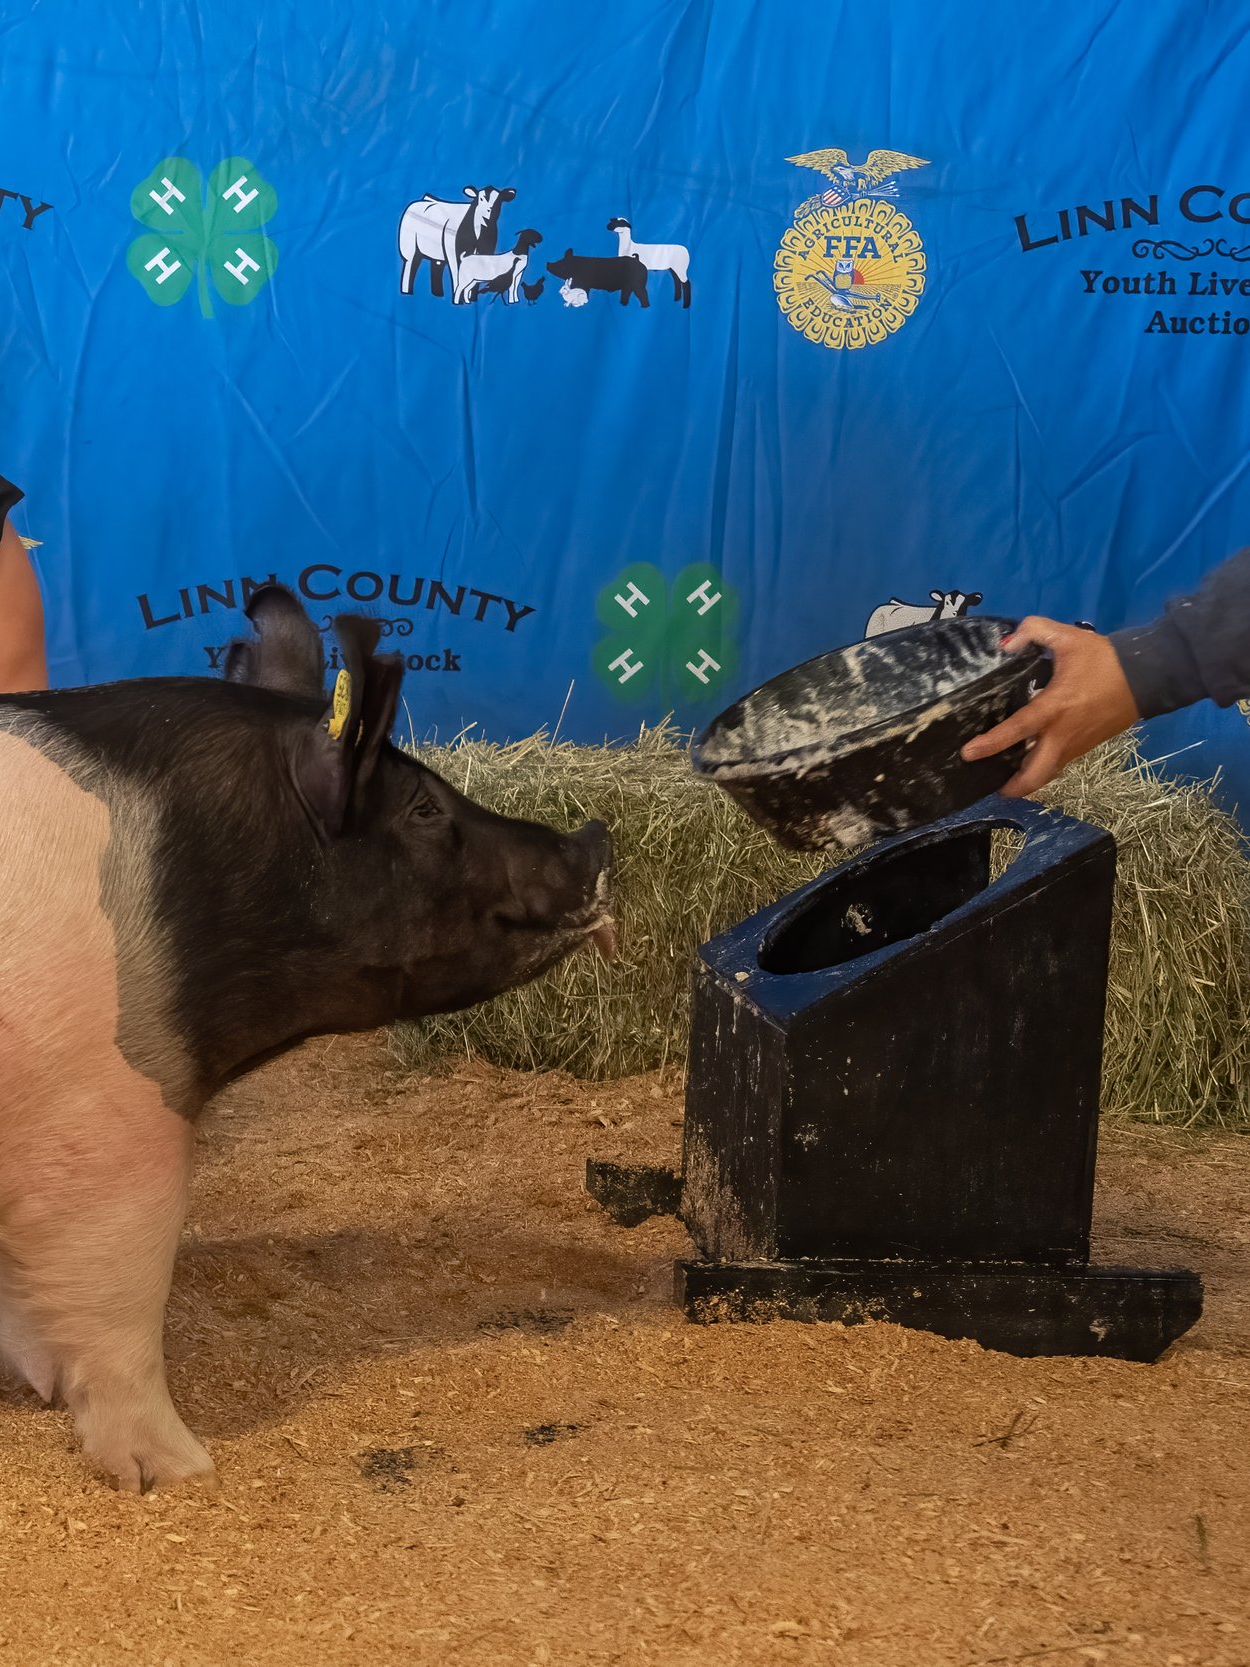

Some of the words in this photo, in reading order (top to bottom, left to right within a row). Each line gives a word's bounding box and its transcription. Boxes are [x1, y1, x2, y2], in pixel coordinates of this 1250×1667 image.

[149, 177, 186, 215] H
[222, 175, 259, 213] H
[798, 216, 903, 263] AGRICULTURAL
[1014, 195, 1159, 252] LINN
[144, 247, 181, 285] H
[223, 247, 261, 285] H
[823, 236, 881, 259] FFA
[1080, 270, 1177, 295] Youth
[803, 298, 892, 328] EDUCATION
[1145, 311, 1250, 335] Auctio
[299, 564, 537, 632] COUNTY
[614, 581, 650, 618] H
[686, 579, 722, 616] H
[608, 648, 644, 684] H
[685, 648, 721, 684] H
